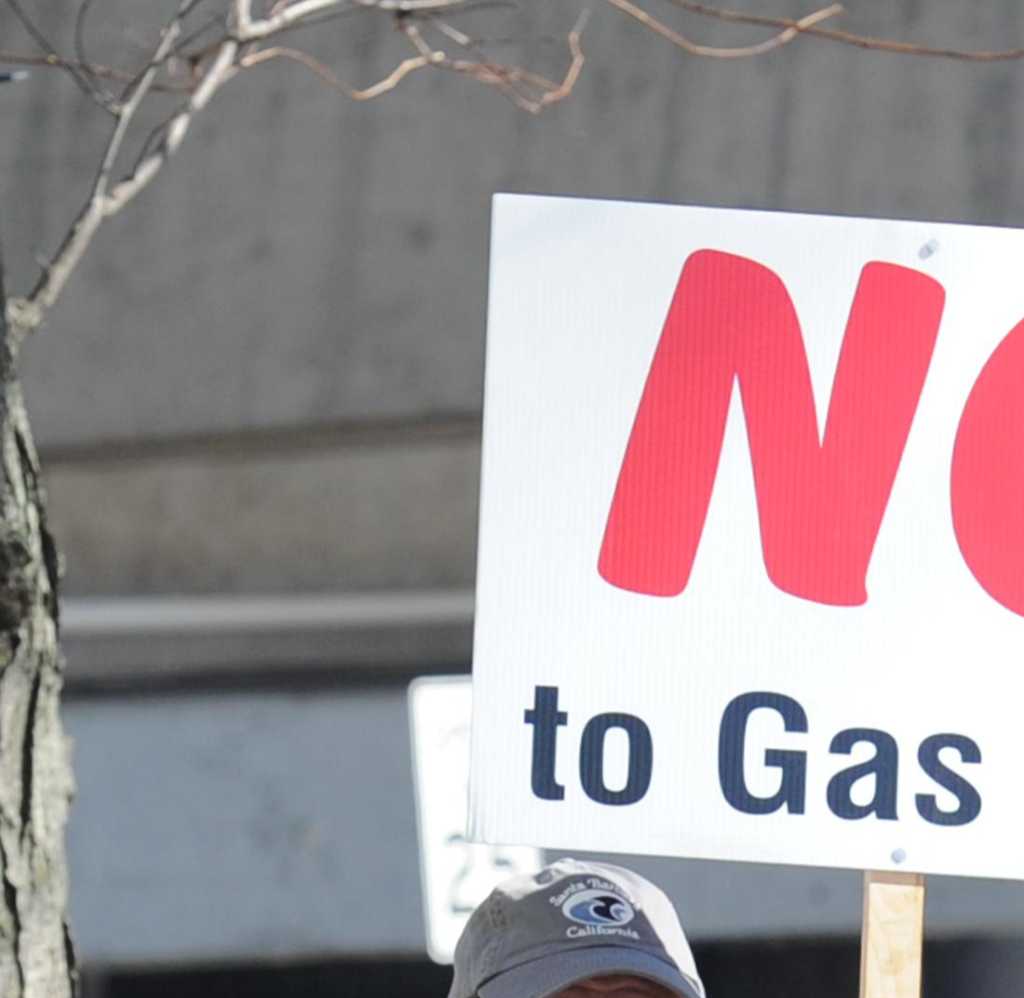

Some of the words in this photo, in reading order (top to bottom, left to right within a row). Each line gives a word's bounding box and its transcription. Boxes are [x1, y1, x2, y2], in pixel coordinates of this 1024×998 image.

[524, 685, 653, 806] to
[718, 691, 982, 827] Gas
[566, 925, 640, 939] California
